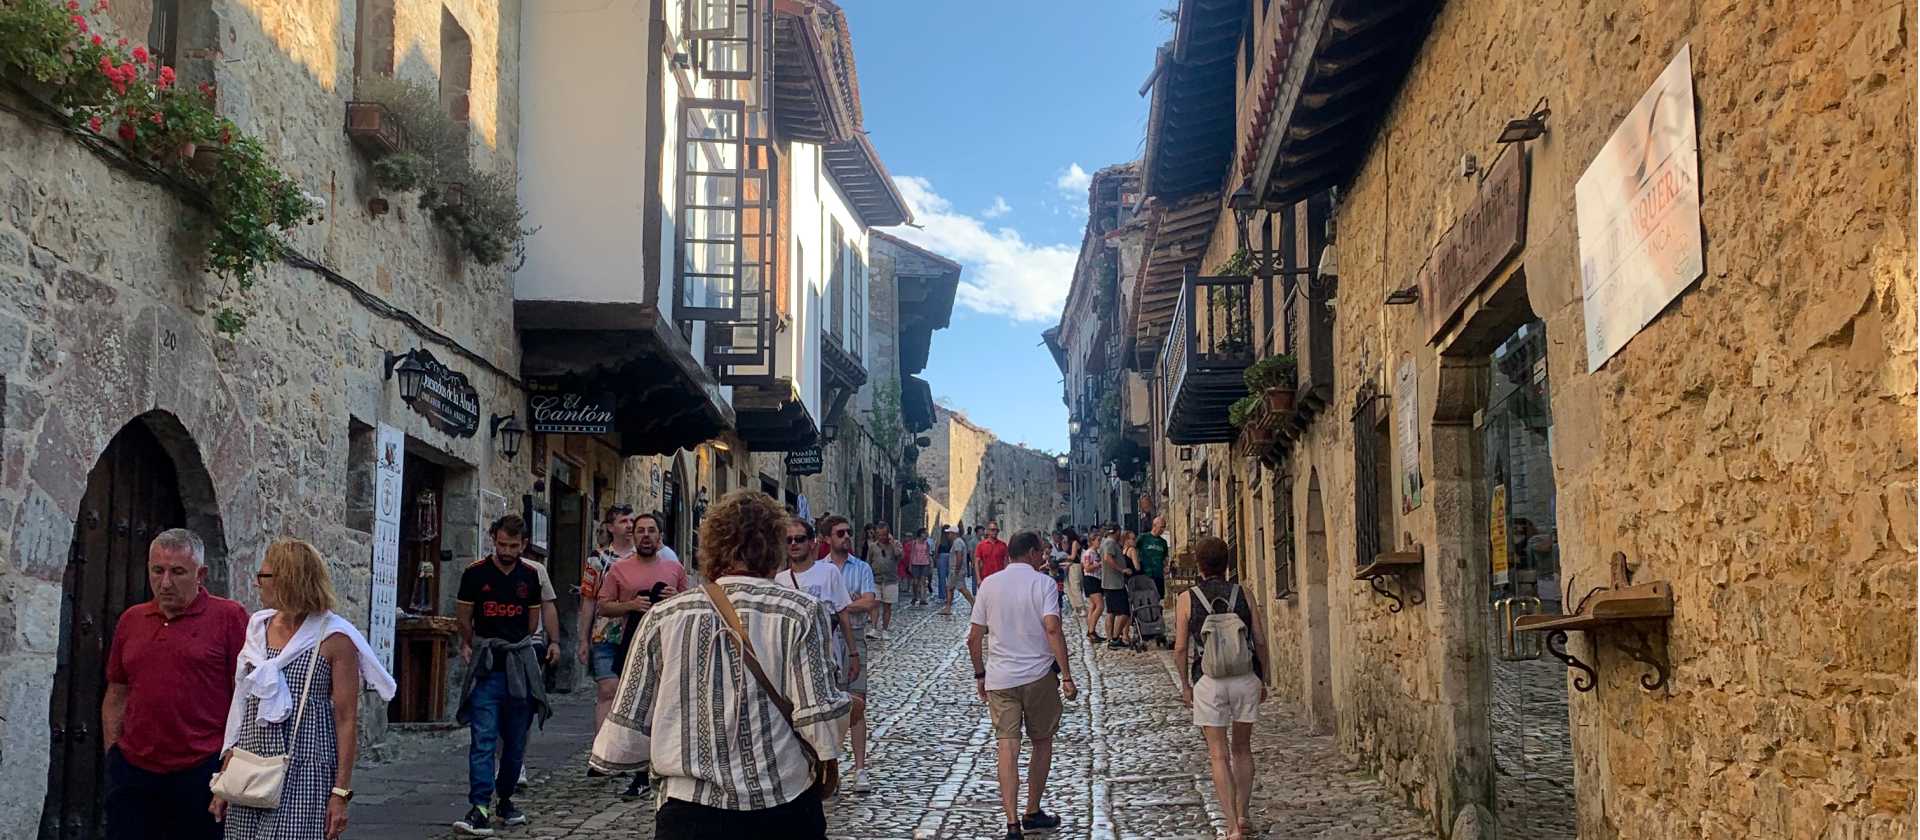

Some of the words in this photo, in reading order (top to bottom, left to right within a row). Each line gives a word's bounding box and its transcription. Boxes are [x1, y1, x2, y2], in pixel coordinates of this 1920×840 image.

[163, 329, 177, 351] 20
[530, 395, 615, 424] Cantón
[563, 393, 582, 409] El
